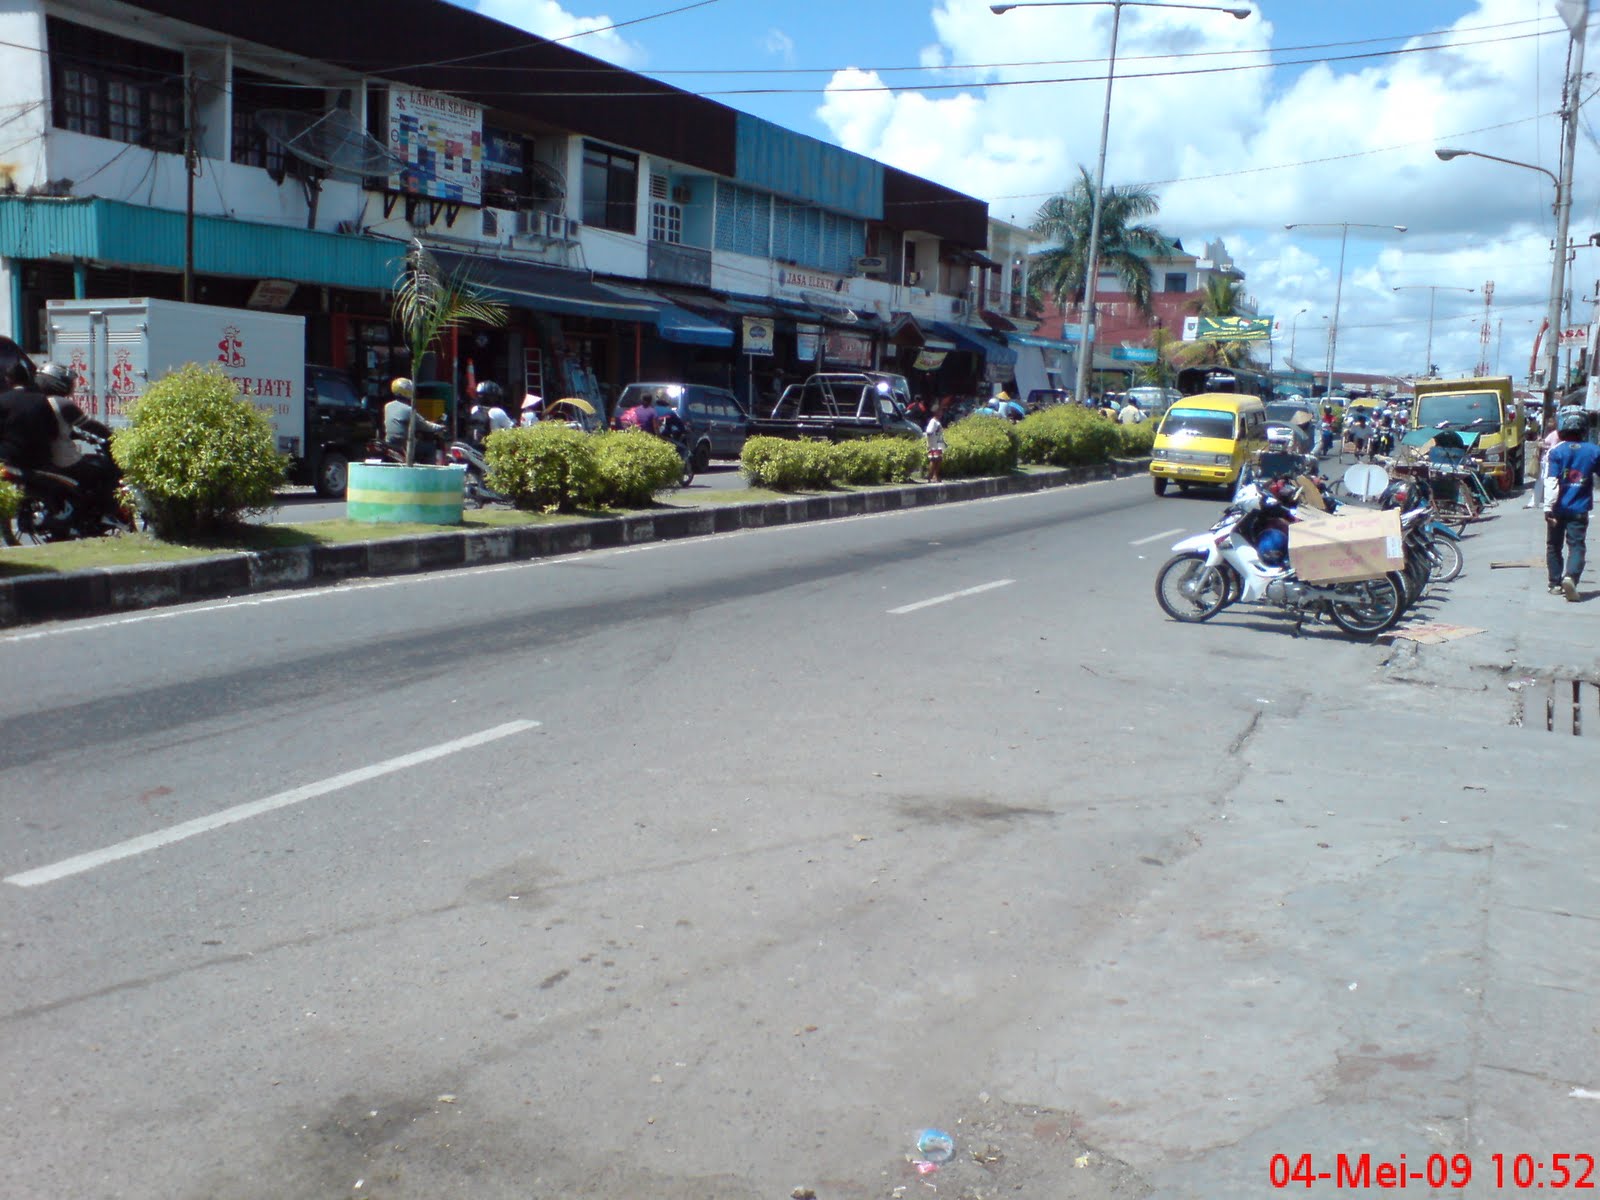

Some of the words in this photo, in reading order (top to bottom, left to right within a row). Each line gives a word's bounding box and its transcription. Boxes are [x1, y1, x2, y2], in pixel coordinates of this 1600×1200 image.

[409, 90, 446, 112] LANCAR
[448, 100, 477, 118] SEJATI
[787, 272, 807, 287] JASA
